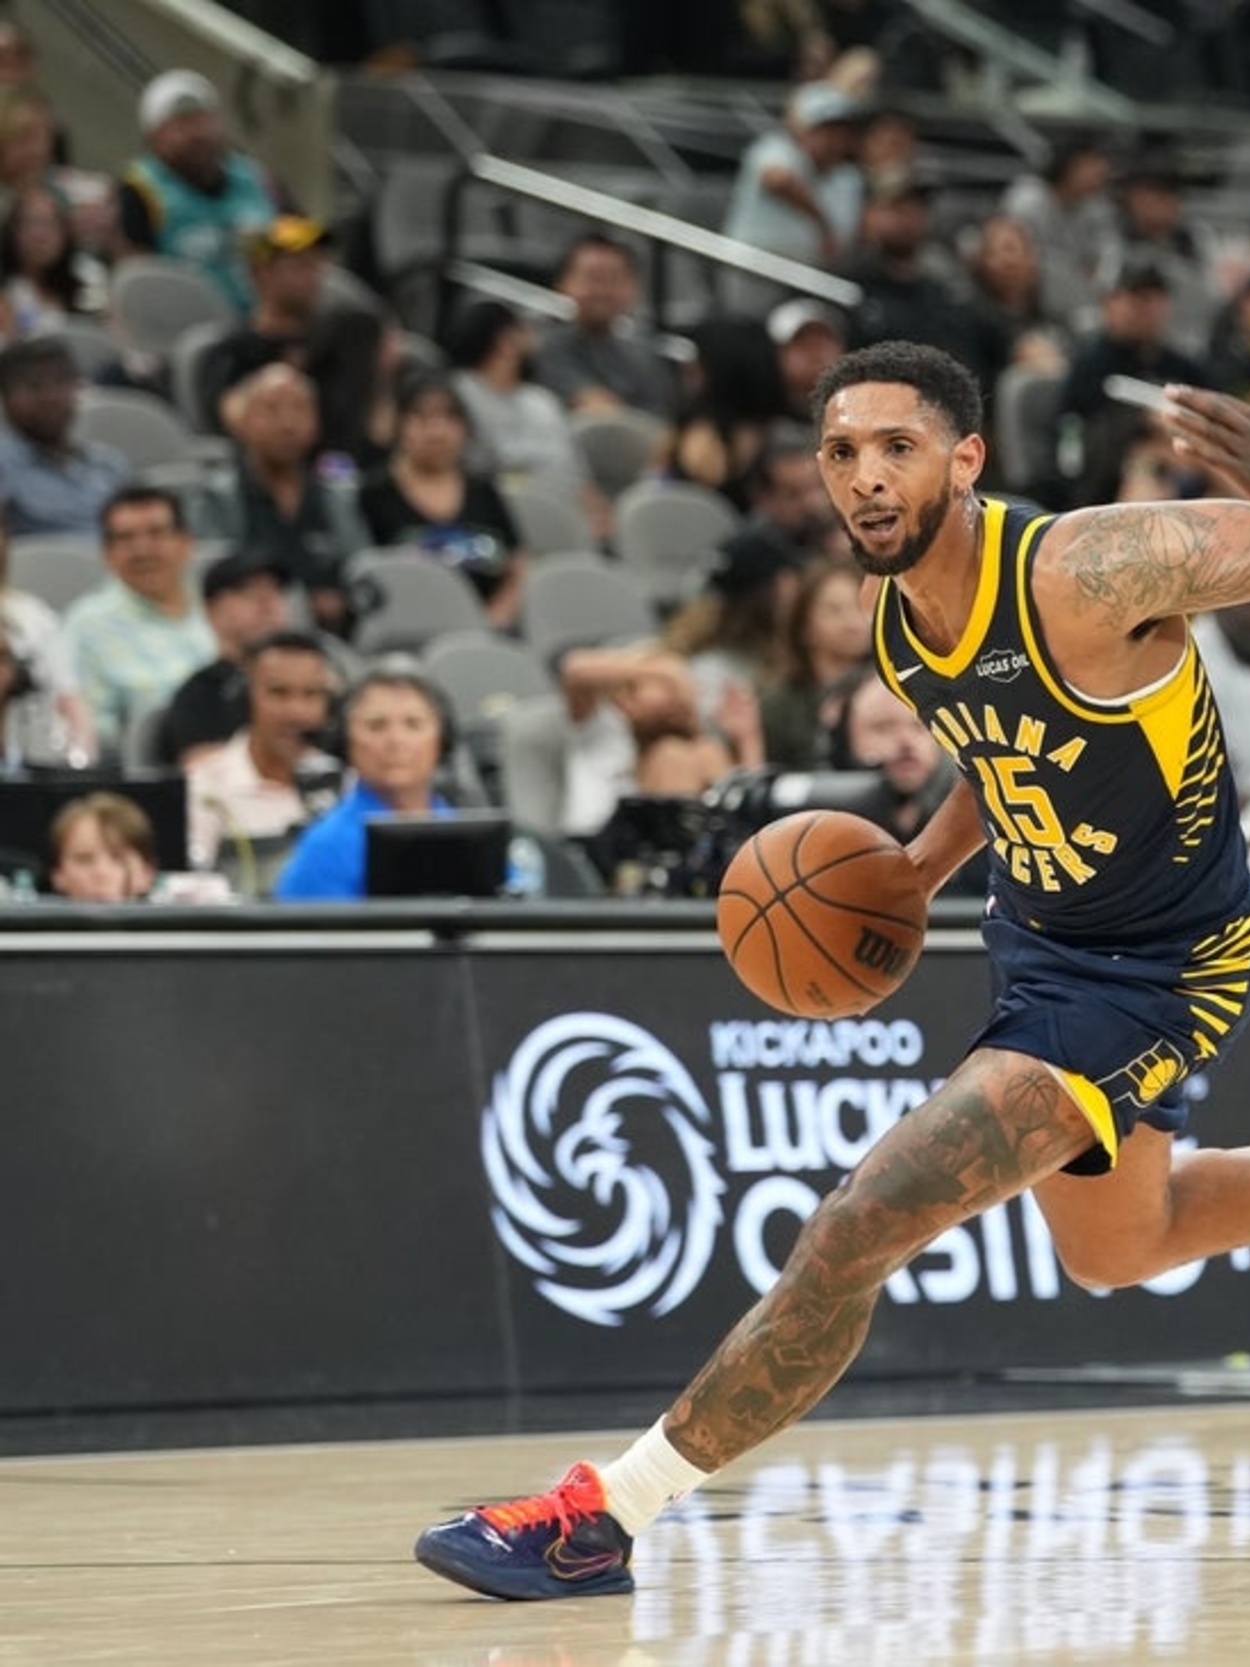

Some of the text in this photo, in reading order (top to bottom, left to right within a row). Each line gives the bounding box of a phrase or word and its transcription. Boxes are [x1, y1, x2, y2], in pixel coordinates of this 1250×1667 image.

[975, 653, 1030, 677] LUCAS OIL
[971, 756, 1066, 848] 15
[710, 1019, 925, 1068] KICKAPOO
[717, 1071, 945, 1172] LUCK
